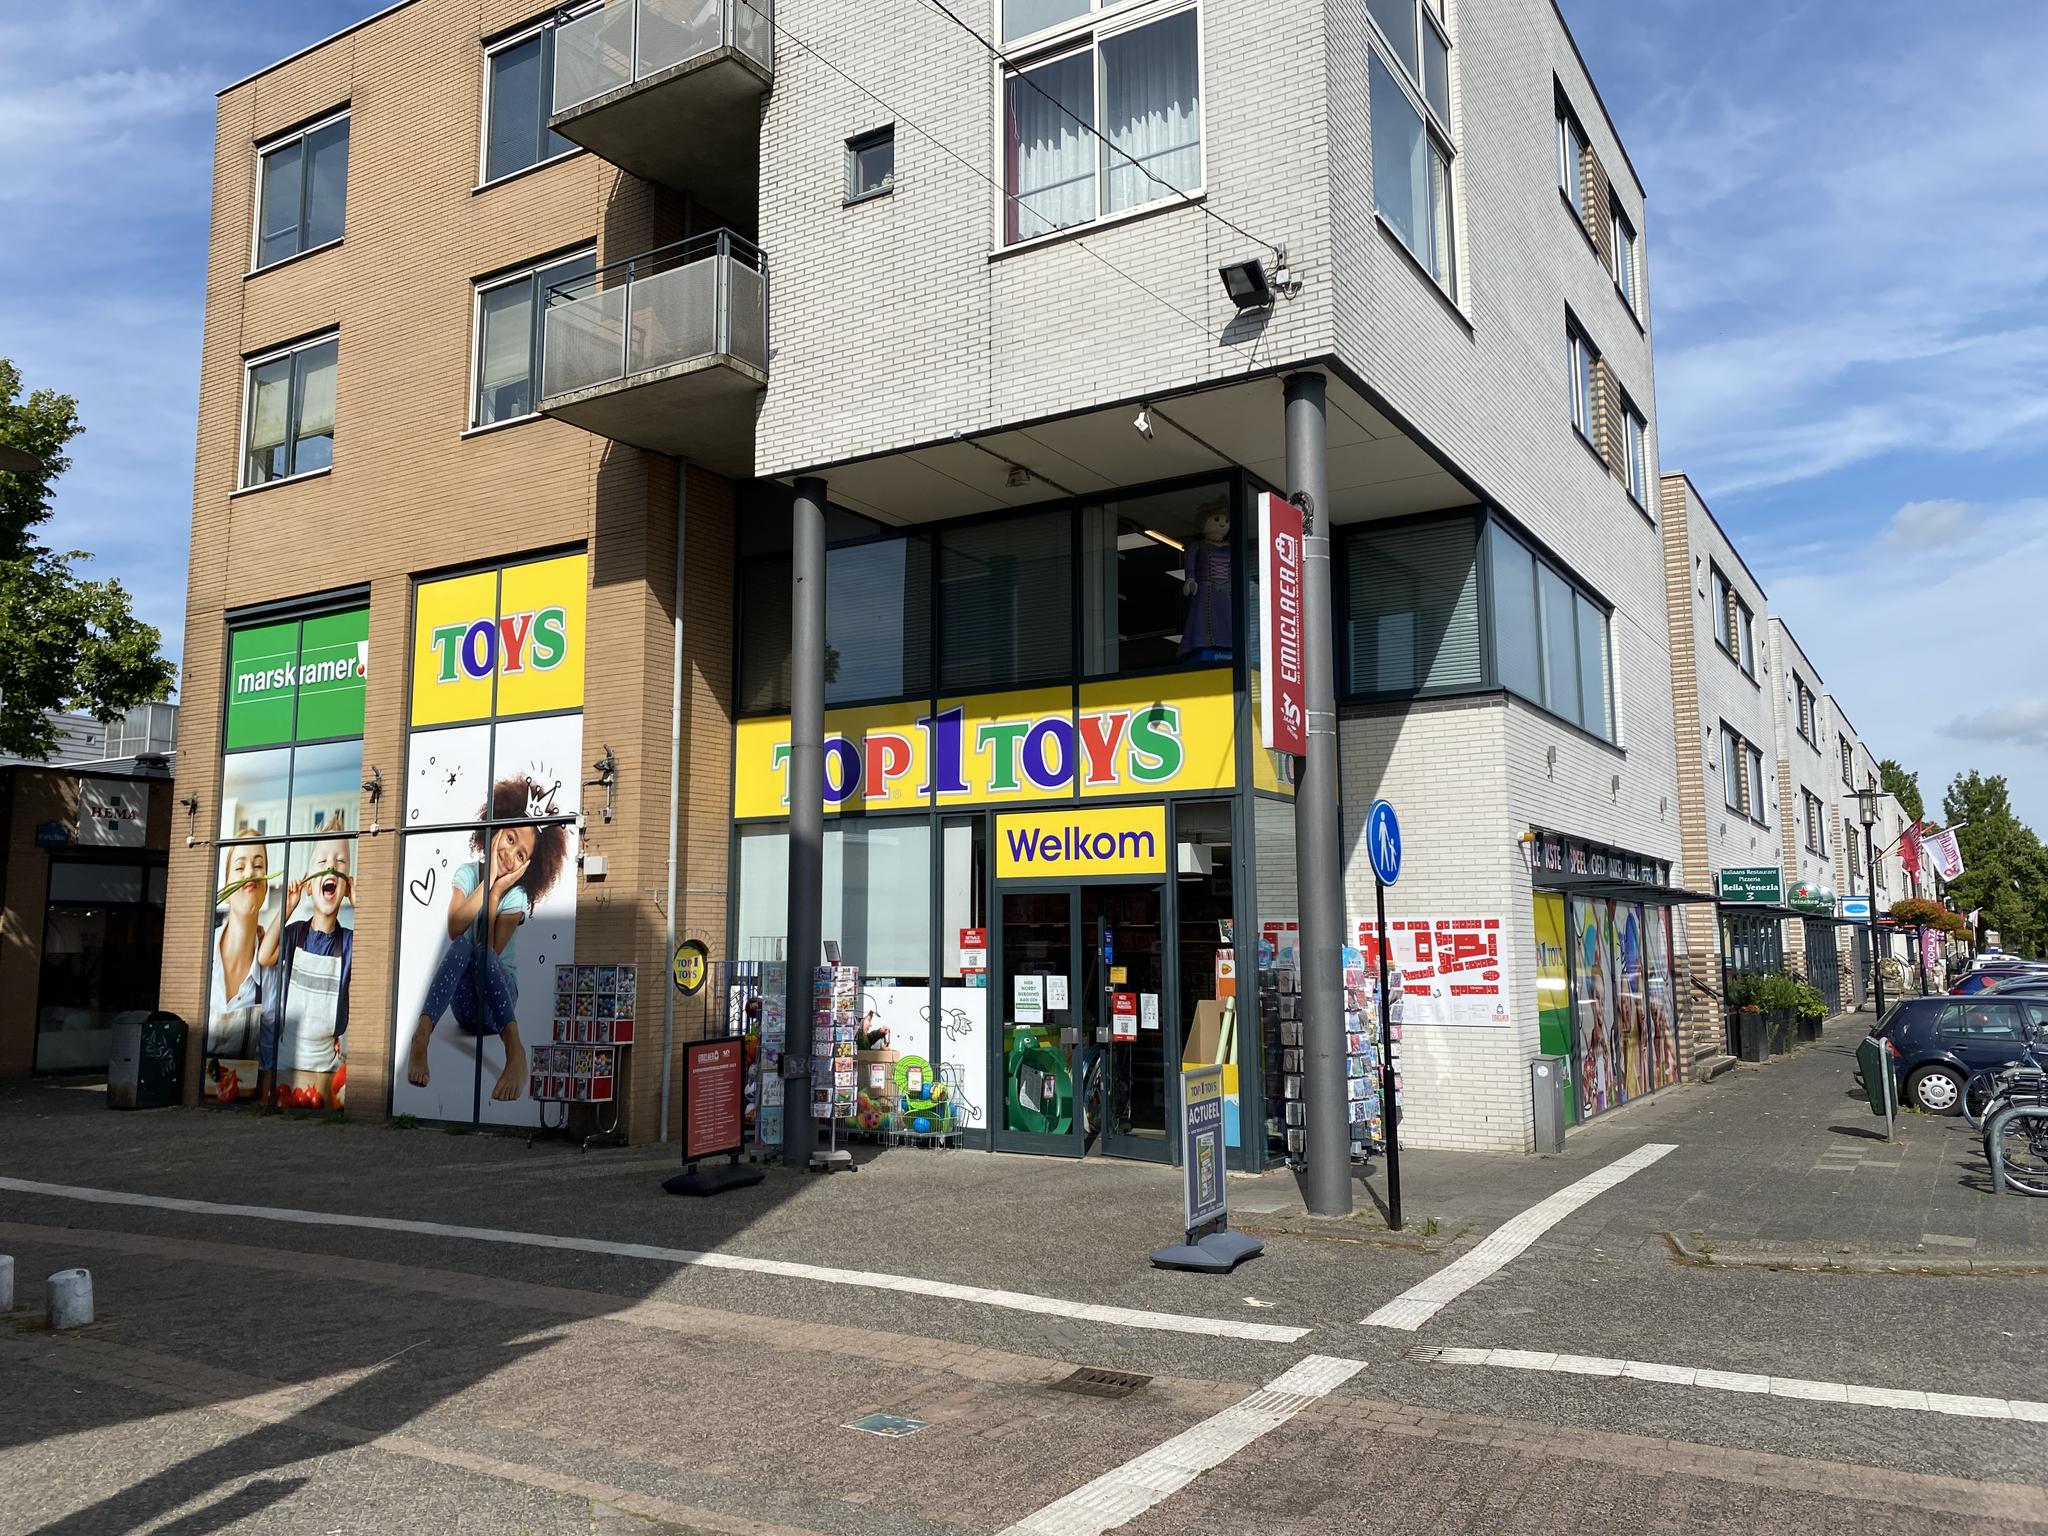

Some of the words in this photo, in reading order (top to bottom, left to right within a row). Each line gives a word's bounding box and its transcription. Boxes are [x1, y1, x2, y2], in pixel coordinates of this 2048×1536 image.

[1280, 566, 1297, 683] EMICLAER
[431, 606, 567, 685] TOYS
[237, 657, 357, 695] marskramer
[917, 705, 971, 798] 1
[976, 705, 1183, 793] TOYS
[91, 806, 139, 820] HEMA
[1006, 827, 1155, 863] Welkom
[1746, 893, 1755, 901] 3
[677, 958, 692, 967] TOP
[693, 956, 699, 967] 1
[677, 970, 697, 979] TOYS
[1191, 1085, 1201, 1097] TOP
[1205, 1081, 1217, 1093] TOYS
[1188, 1101, 1221, 1126] ACTUEEL
